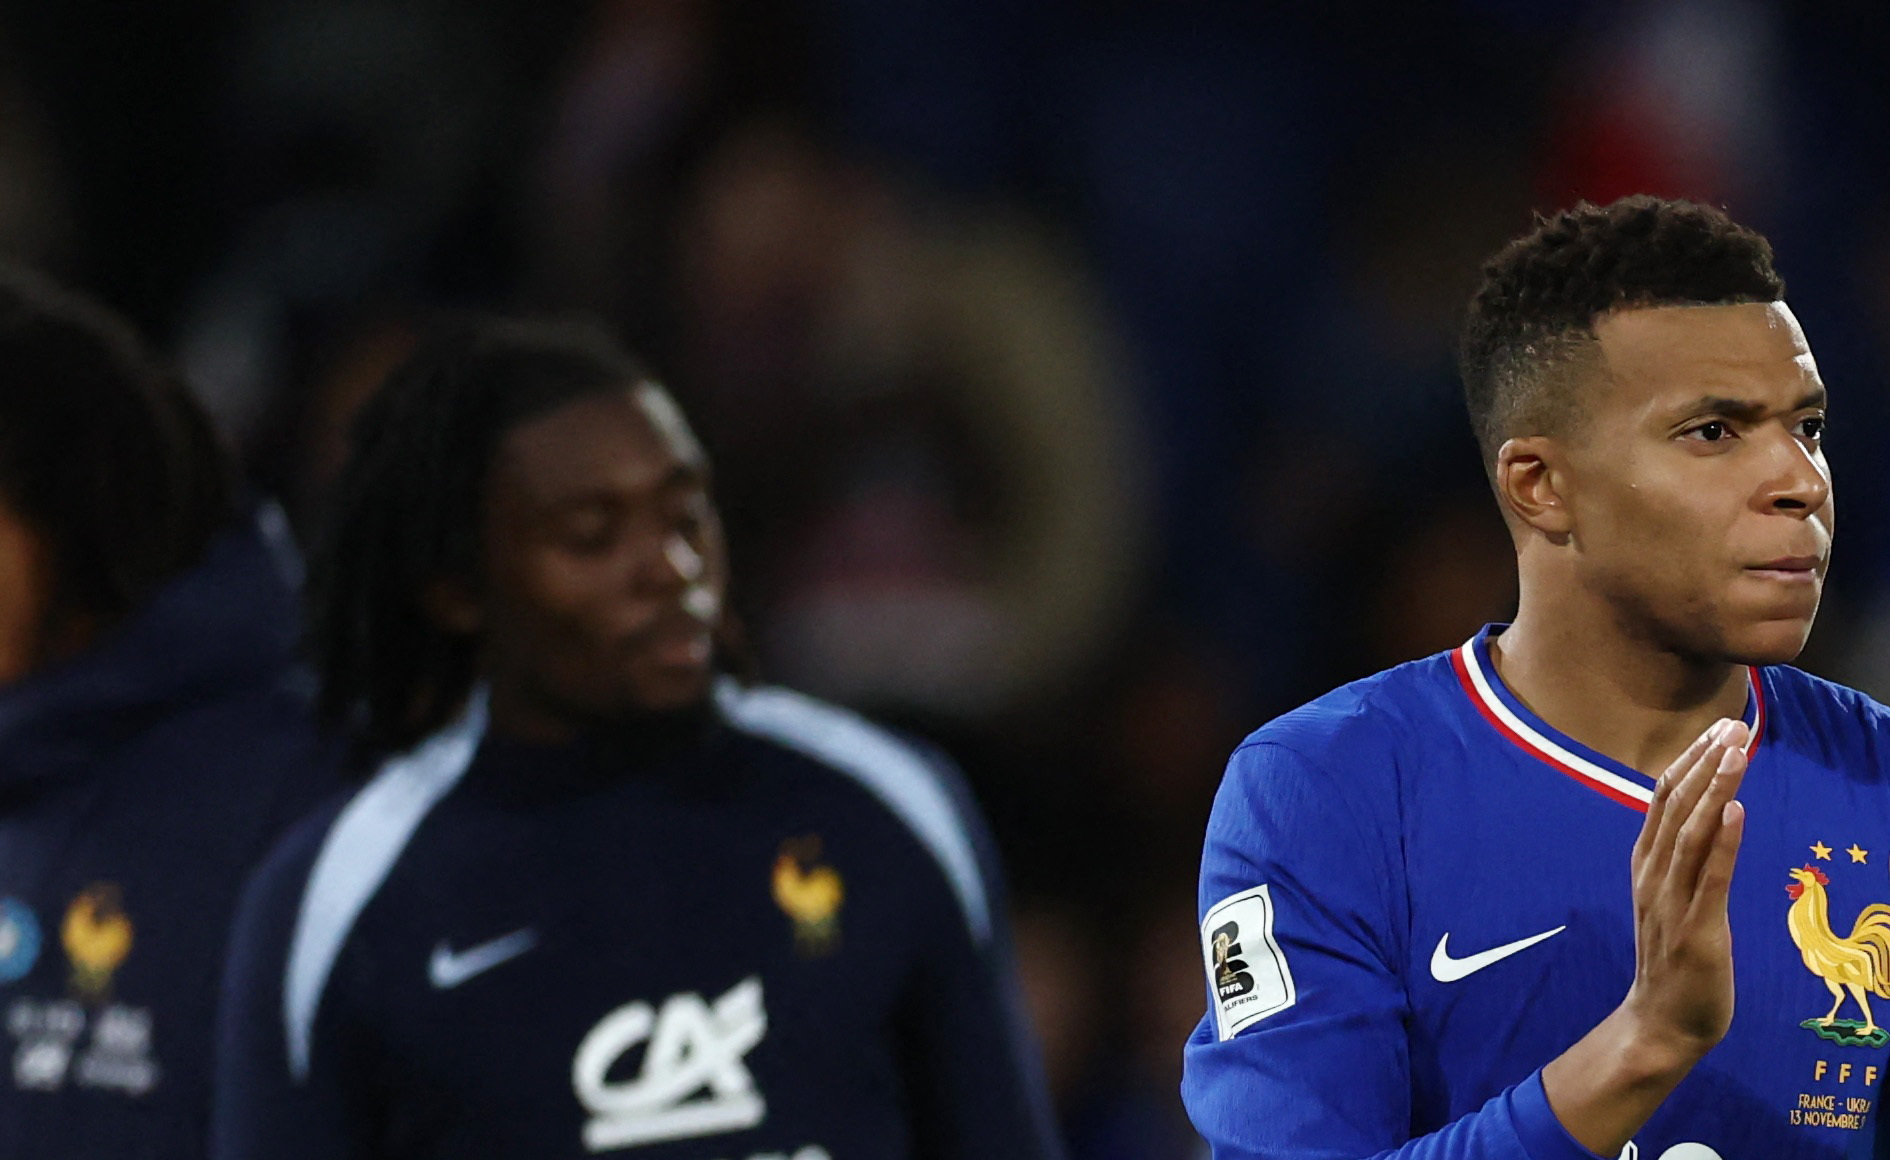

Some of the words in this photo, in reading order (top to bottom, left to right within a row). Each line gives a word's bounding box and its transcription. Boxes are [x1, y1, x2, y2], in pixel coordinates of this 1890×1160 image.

[1220, 983, 1243, 997] FIFA
[1798, 1093, 1836, 1111] FRANCE
[1789, 1109, 1802, 1125] 13
[1804, 1111, 1859, 1130] NOVEMBRE
